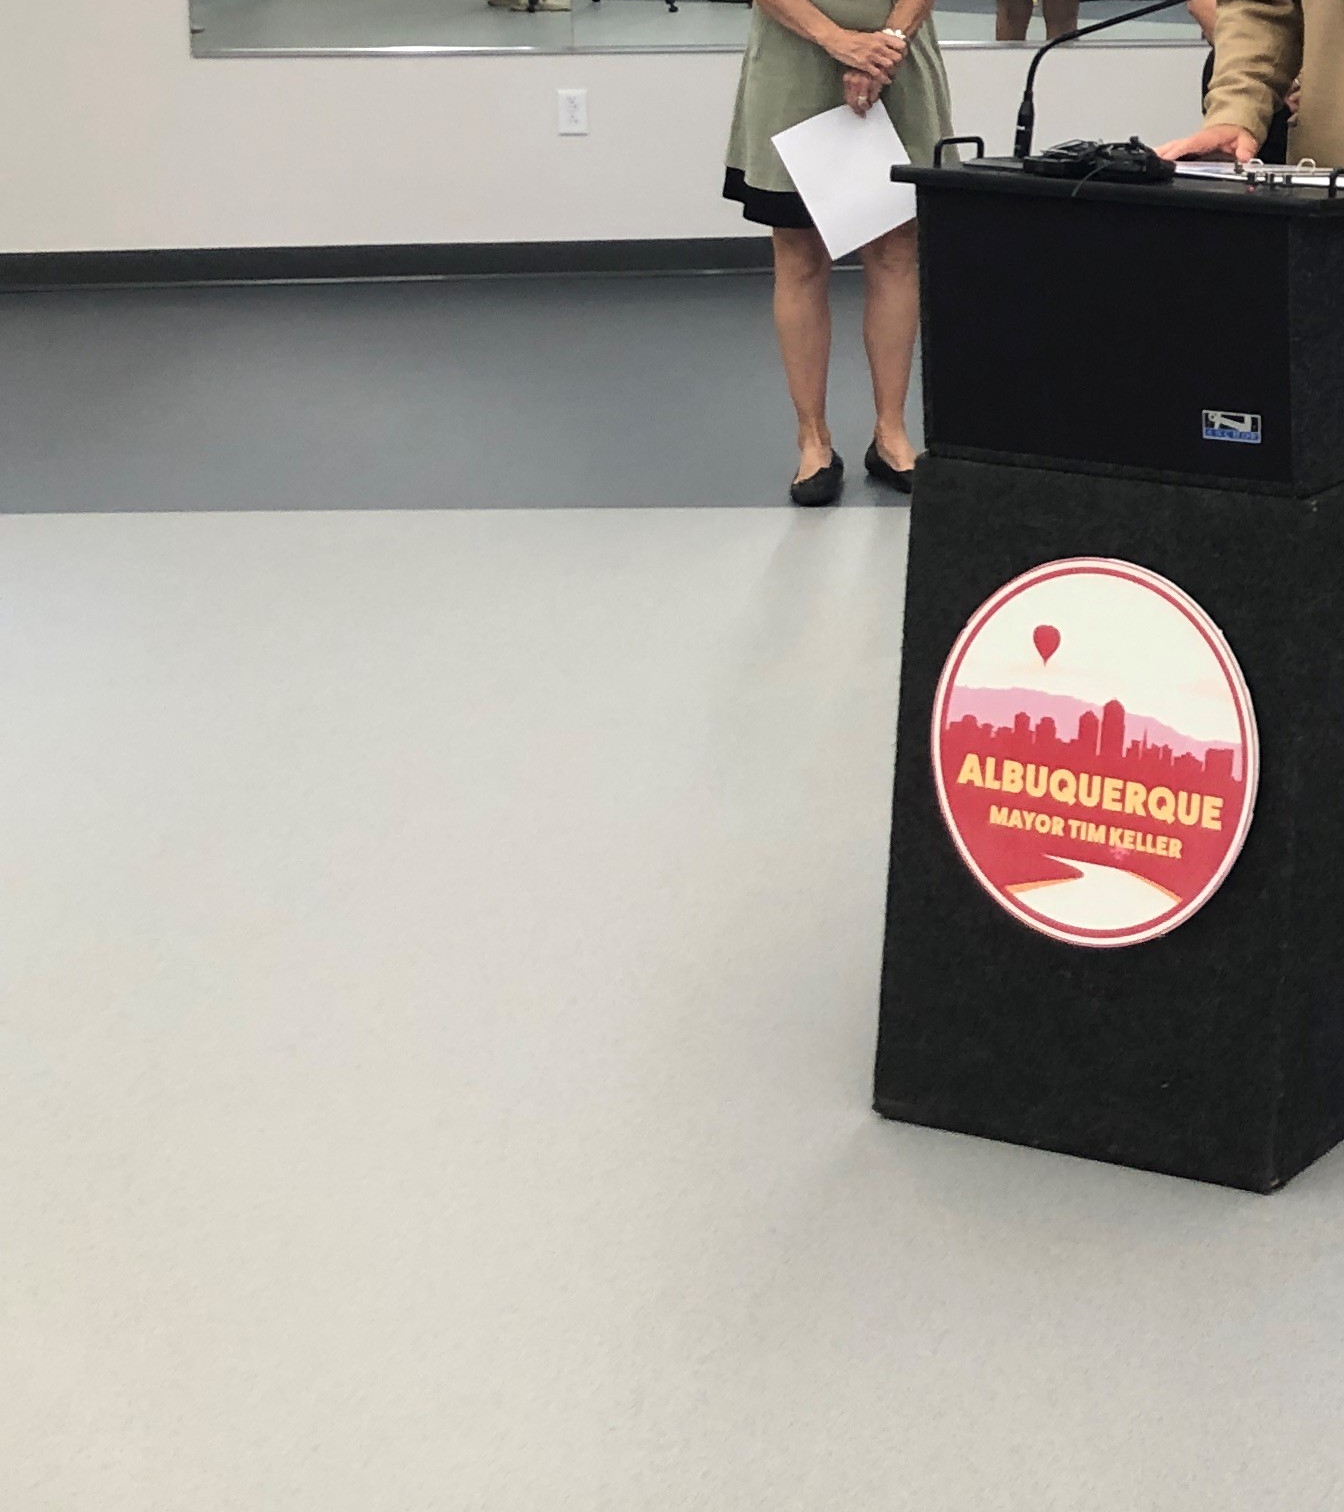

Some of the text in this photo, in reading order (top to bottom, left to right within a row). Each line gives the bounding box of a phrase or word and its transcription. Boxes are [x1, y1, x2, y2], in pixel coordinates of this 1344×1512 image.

[957, 752, 1225, 831] ALBUQUERQUE
[989, 805, 1183, 859] MAYOR TIM KELLER
